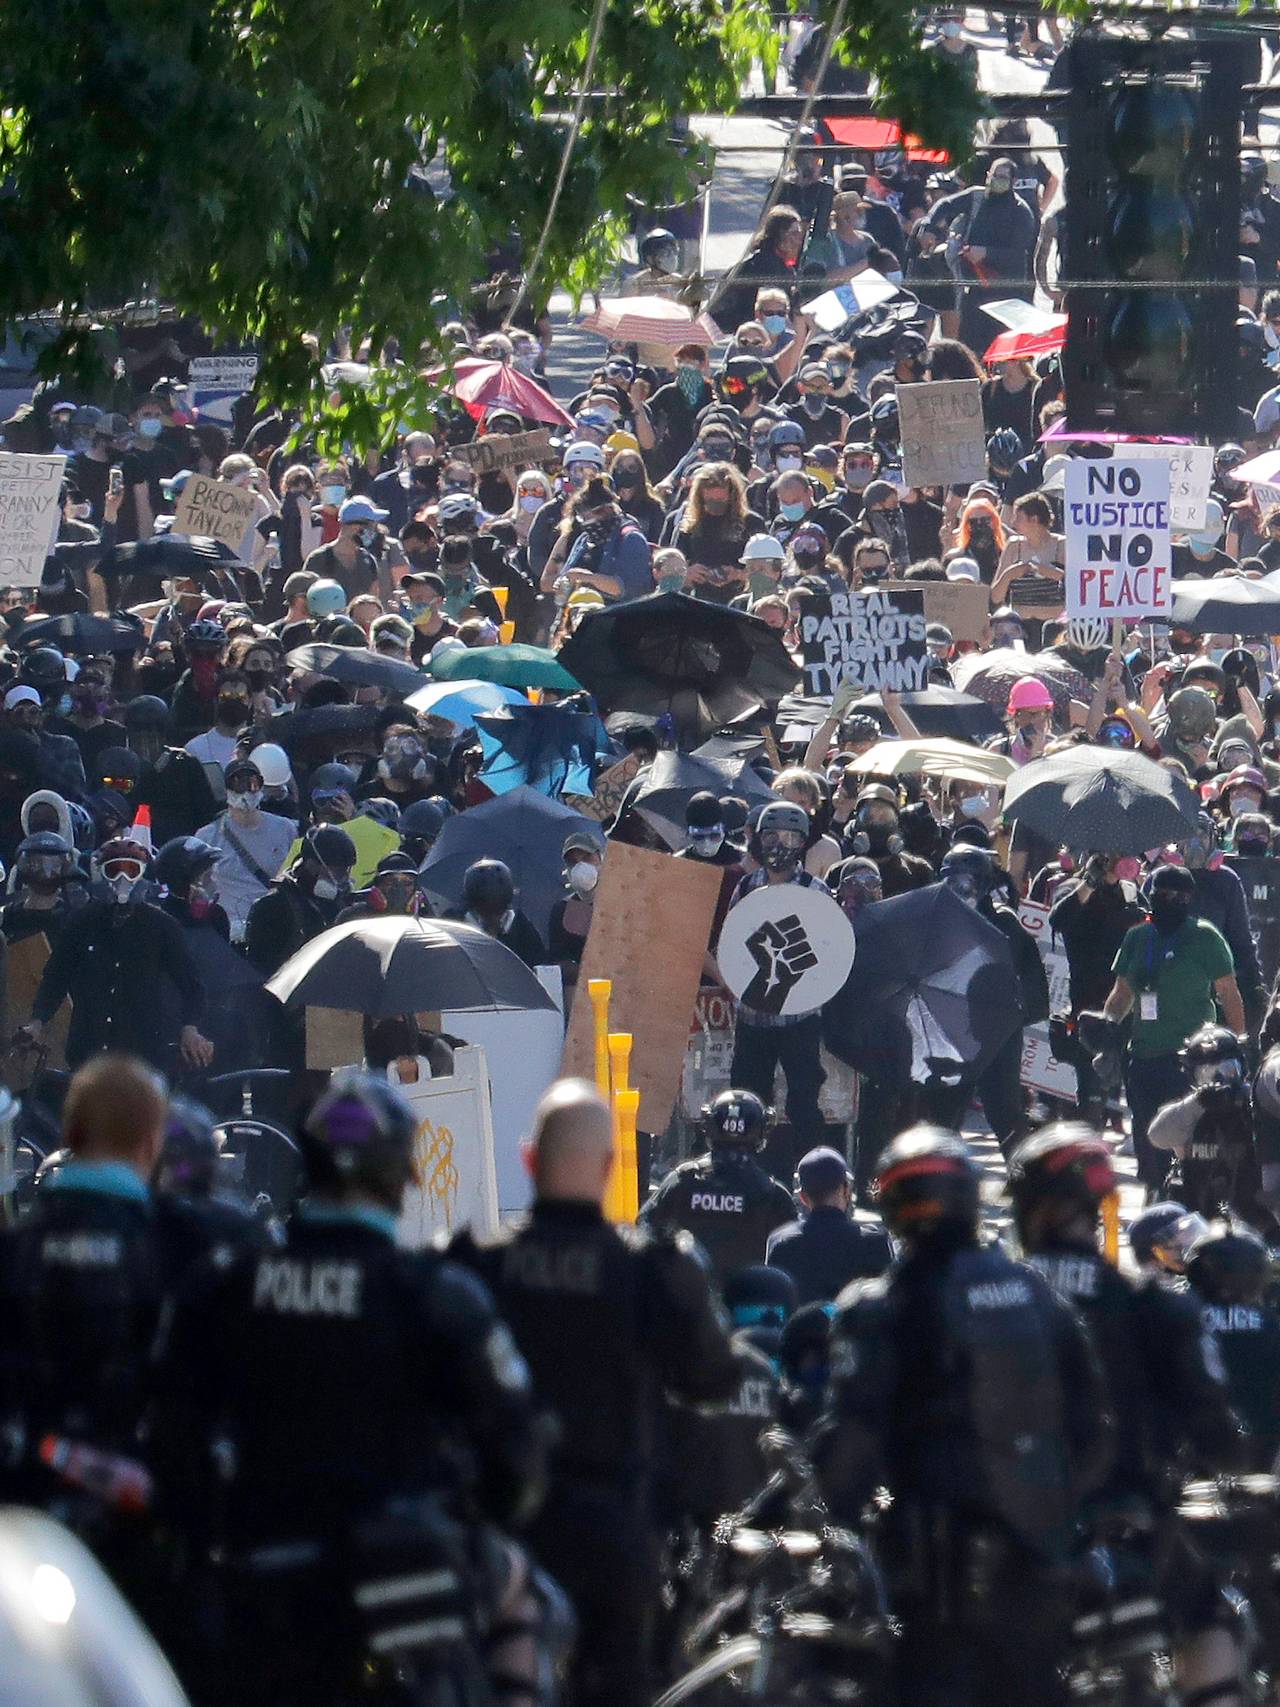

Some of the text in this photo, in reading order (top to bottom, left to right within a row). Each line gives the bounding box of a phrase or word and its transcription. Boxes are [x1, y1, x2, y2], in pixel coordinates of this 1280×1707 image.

[0, 460, 62, 478] ESIST
[1088, 466, 1141, 497] NO
[0, 494, 54, 513] RANNY
[1087, 533, 1153, 567] NO
[1079, 567, 1167, 608] PEACE
[829, 593, 899, 617] REAL
[801, 614, 927, 643] PATRIOTS
[824, 638, 904, 663] FIGHT
[804, 654, 928, 694] TYRANNY
[722, 1119, 745, 1133] 495
[691, 1194, 743, 1212] POLICE
[254, 1256, 364, 1318] POLICE
[1202, 1306, 1262, 1331] OLICE
